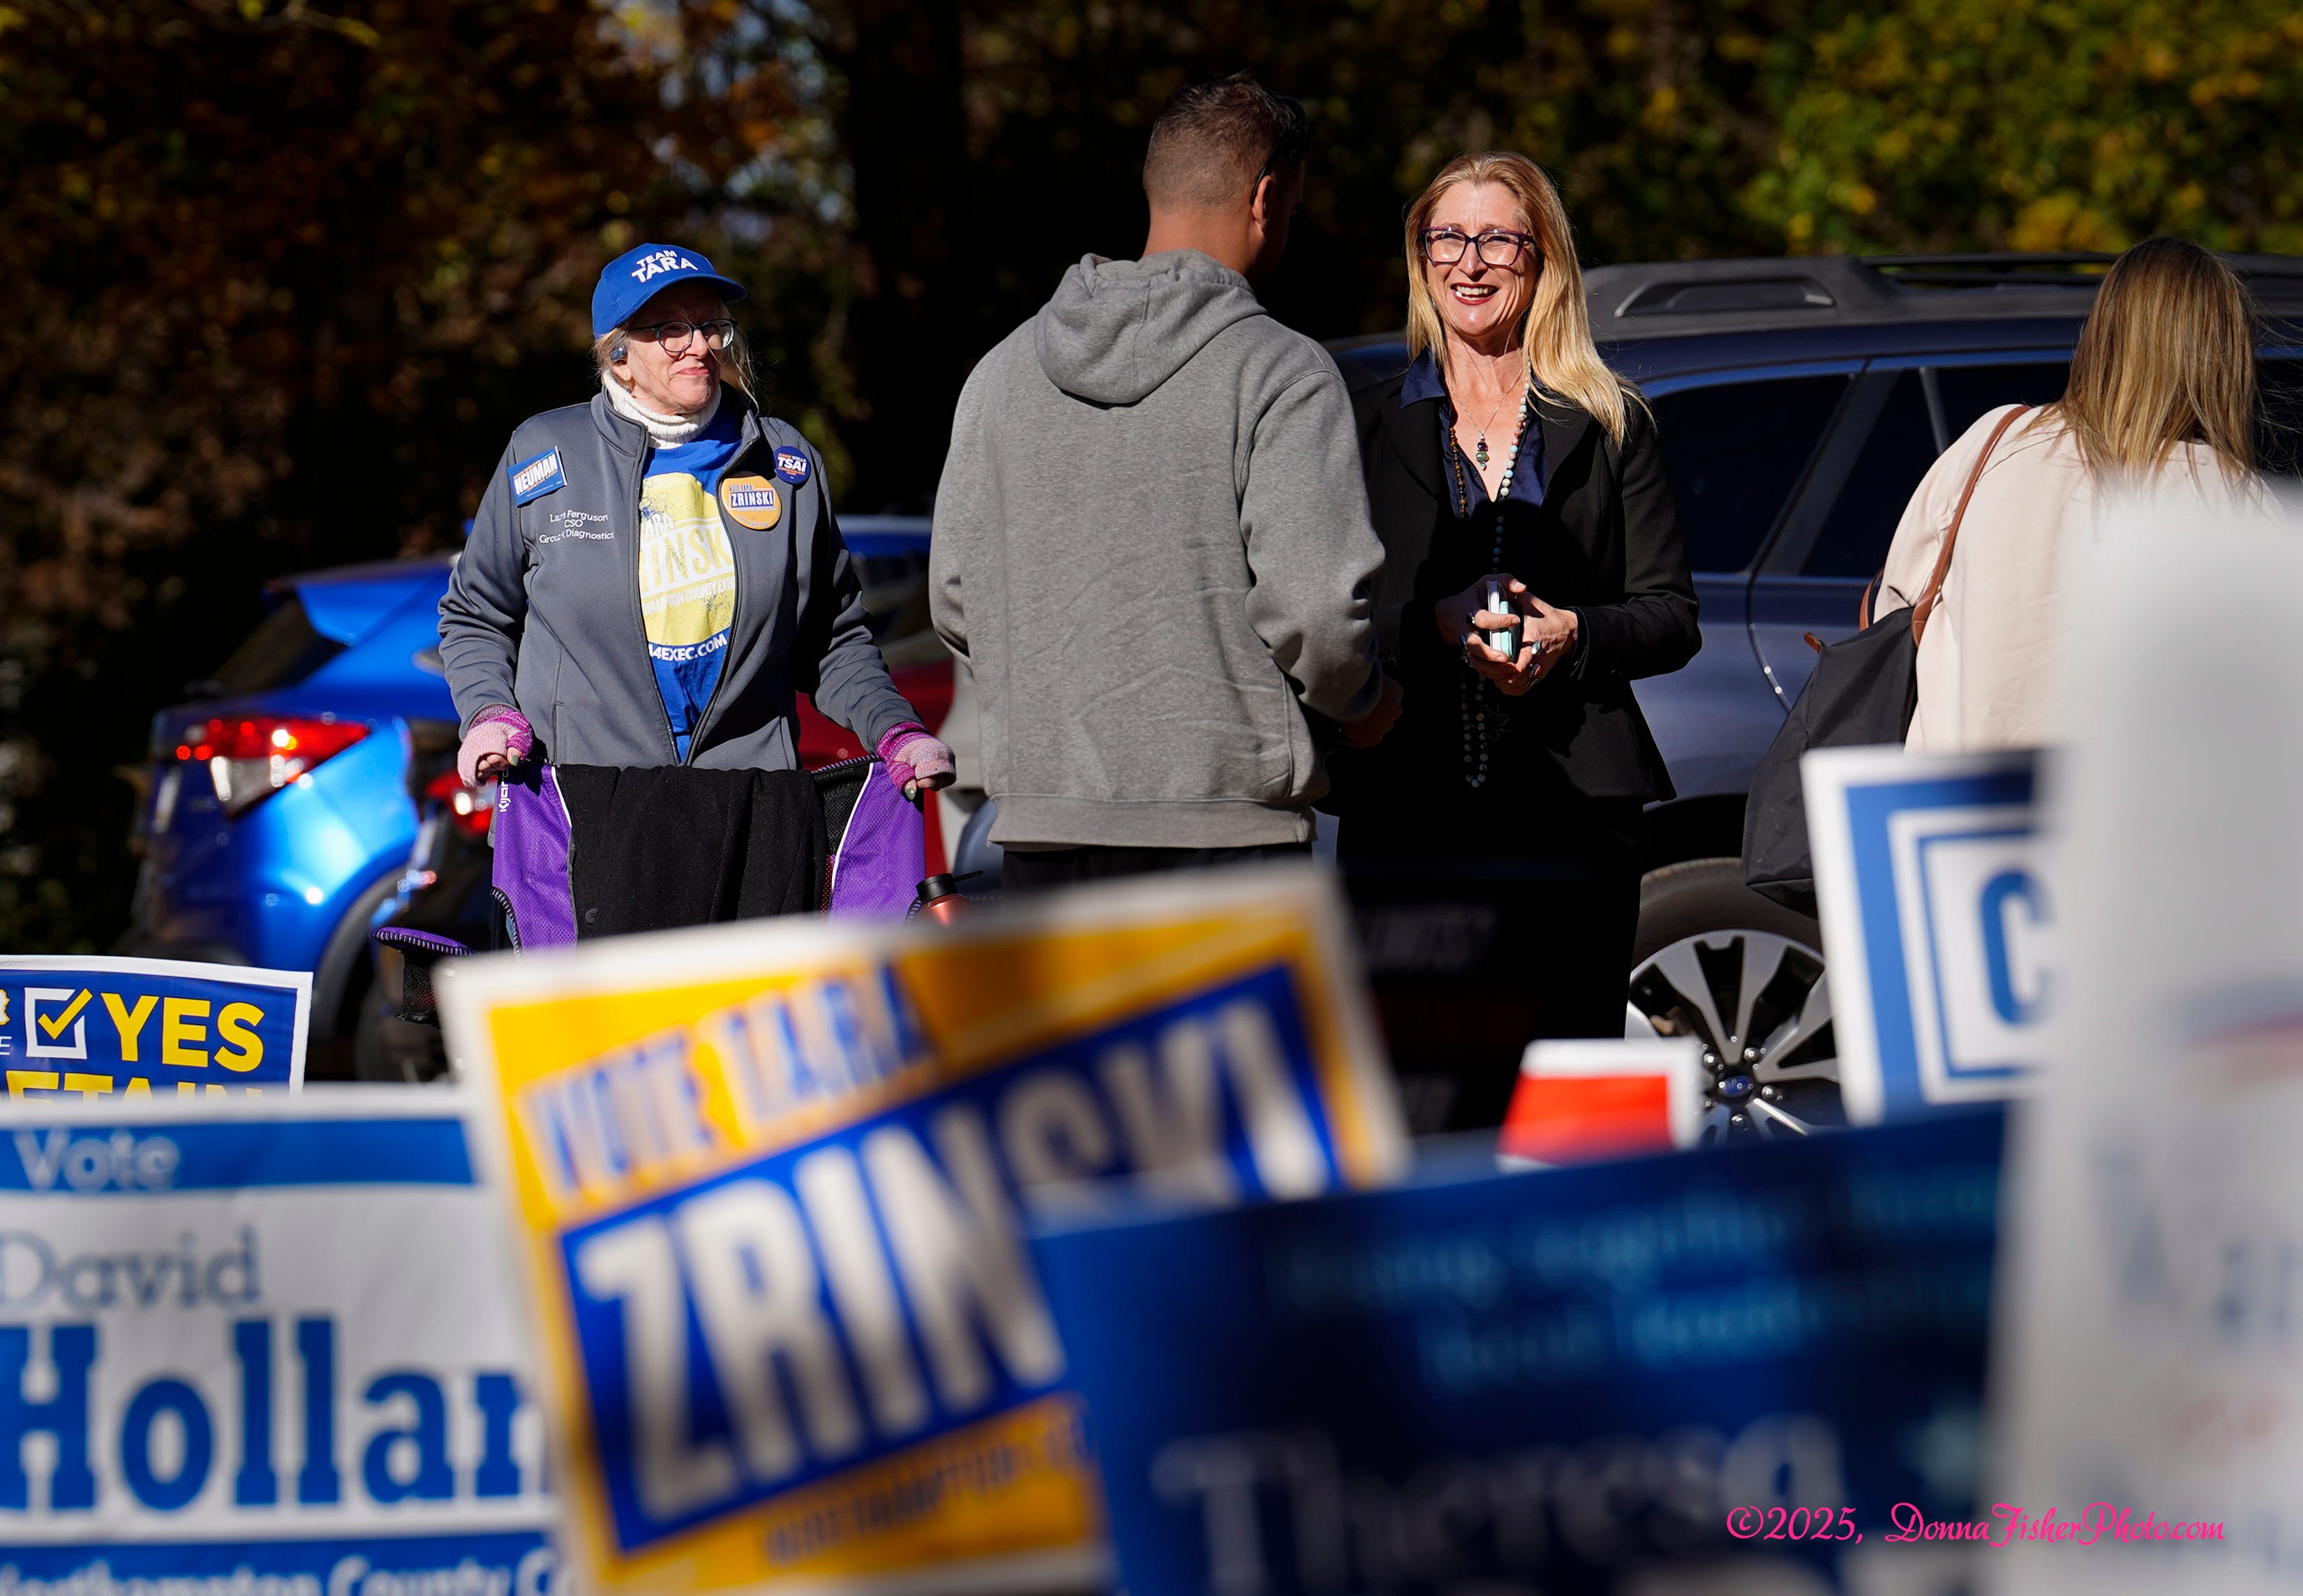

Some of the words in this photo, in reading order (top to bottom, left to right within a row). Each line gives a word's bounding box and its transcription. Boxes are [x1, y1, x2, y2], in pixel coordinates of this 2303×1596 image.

[636, 251, 678, 267] TEAM
[632, 257, 699, 283] TARA
[514, 454, 558, 495] NEUMAN
[777, 456, 807, 472] TSAI
[731, 491, 773, 507] ZRINSKI
[564, 519, 583, 528] CSO
[567, 509, 609, 522] Ferguson
[565, 528, 615, 539] Diagnostics
[100, 992, 265, 1073] YES
[13, 1125, 183, 1192] Vote
[0, 1225, 262, 1310] David
[576, 994, 1332, 1523] ZRINSKI
